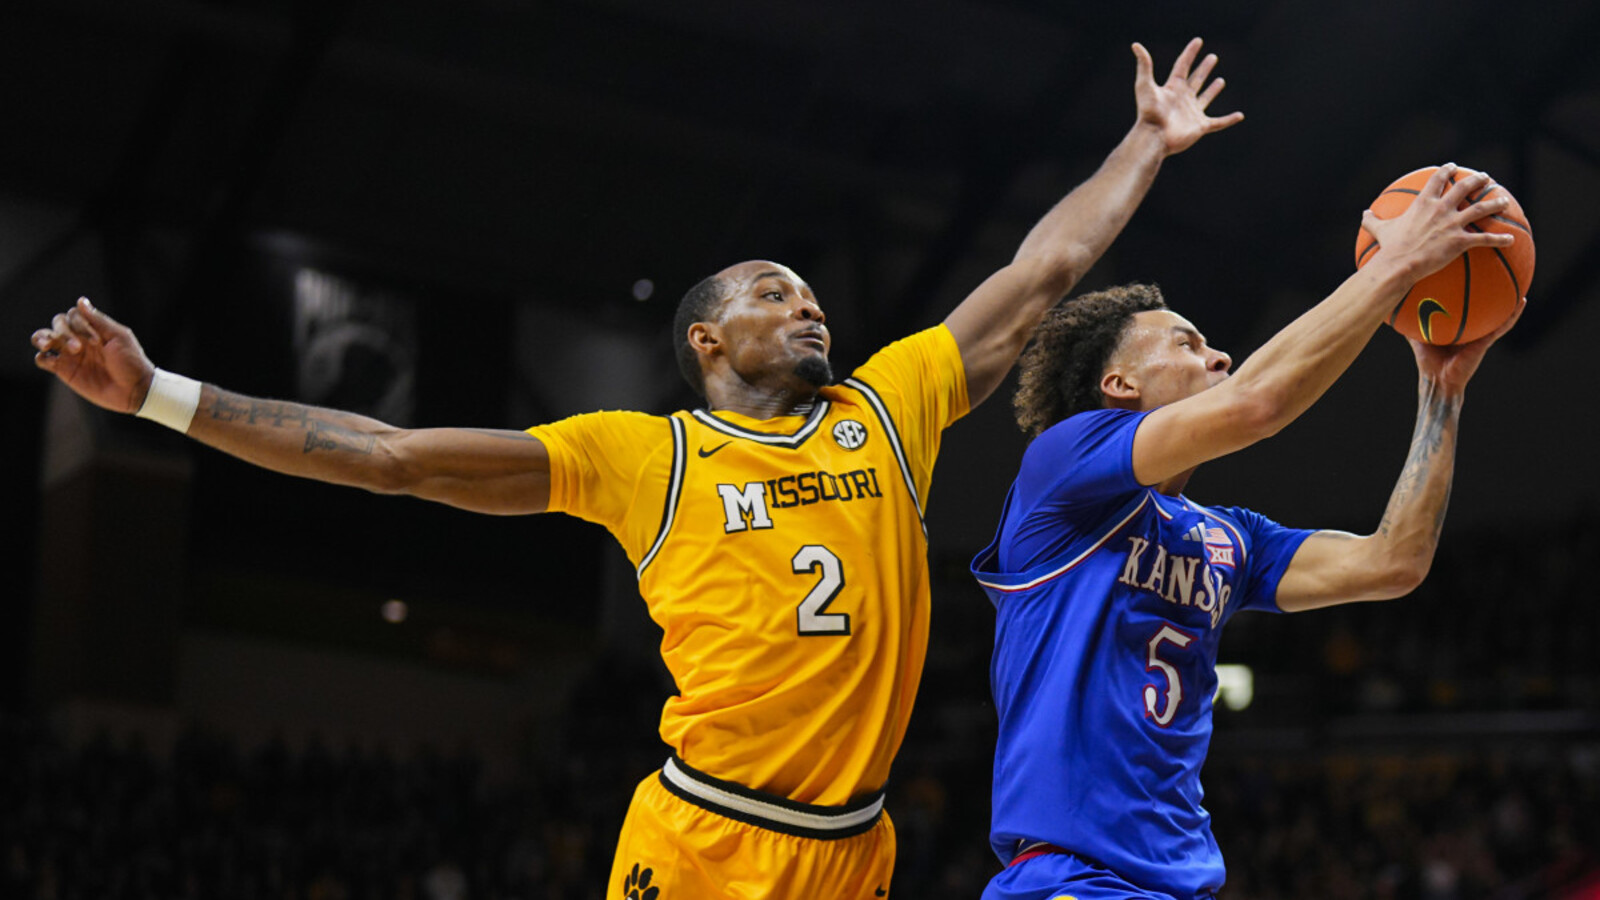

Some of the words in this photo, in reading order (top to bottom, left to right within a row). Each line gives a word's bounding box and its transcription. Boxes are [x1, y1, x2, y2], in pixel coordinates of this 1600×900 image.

[833, 419, 867, 449] SEC
[716, 468, 883, 534] MISSOURI
[1205, 544, 1236, 568] XII
[791, 544, 851, 636] 2
[1142, 621, 1198, 728] 5
